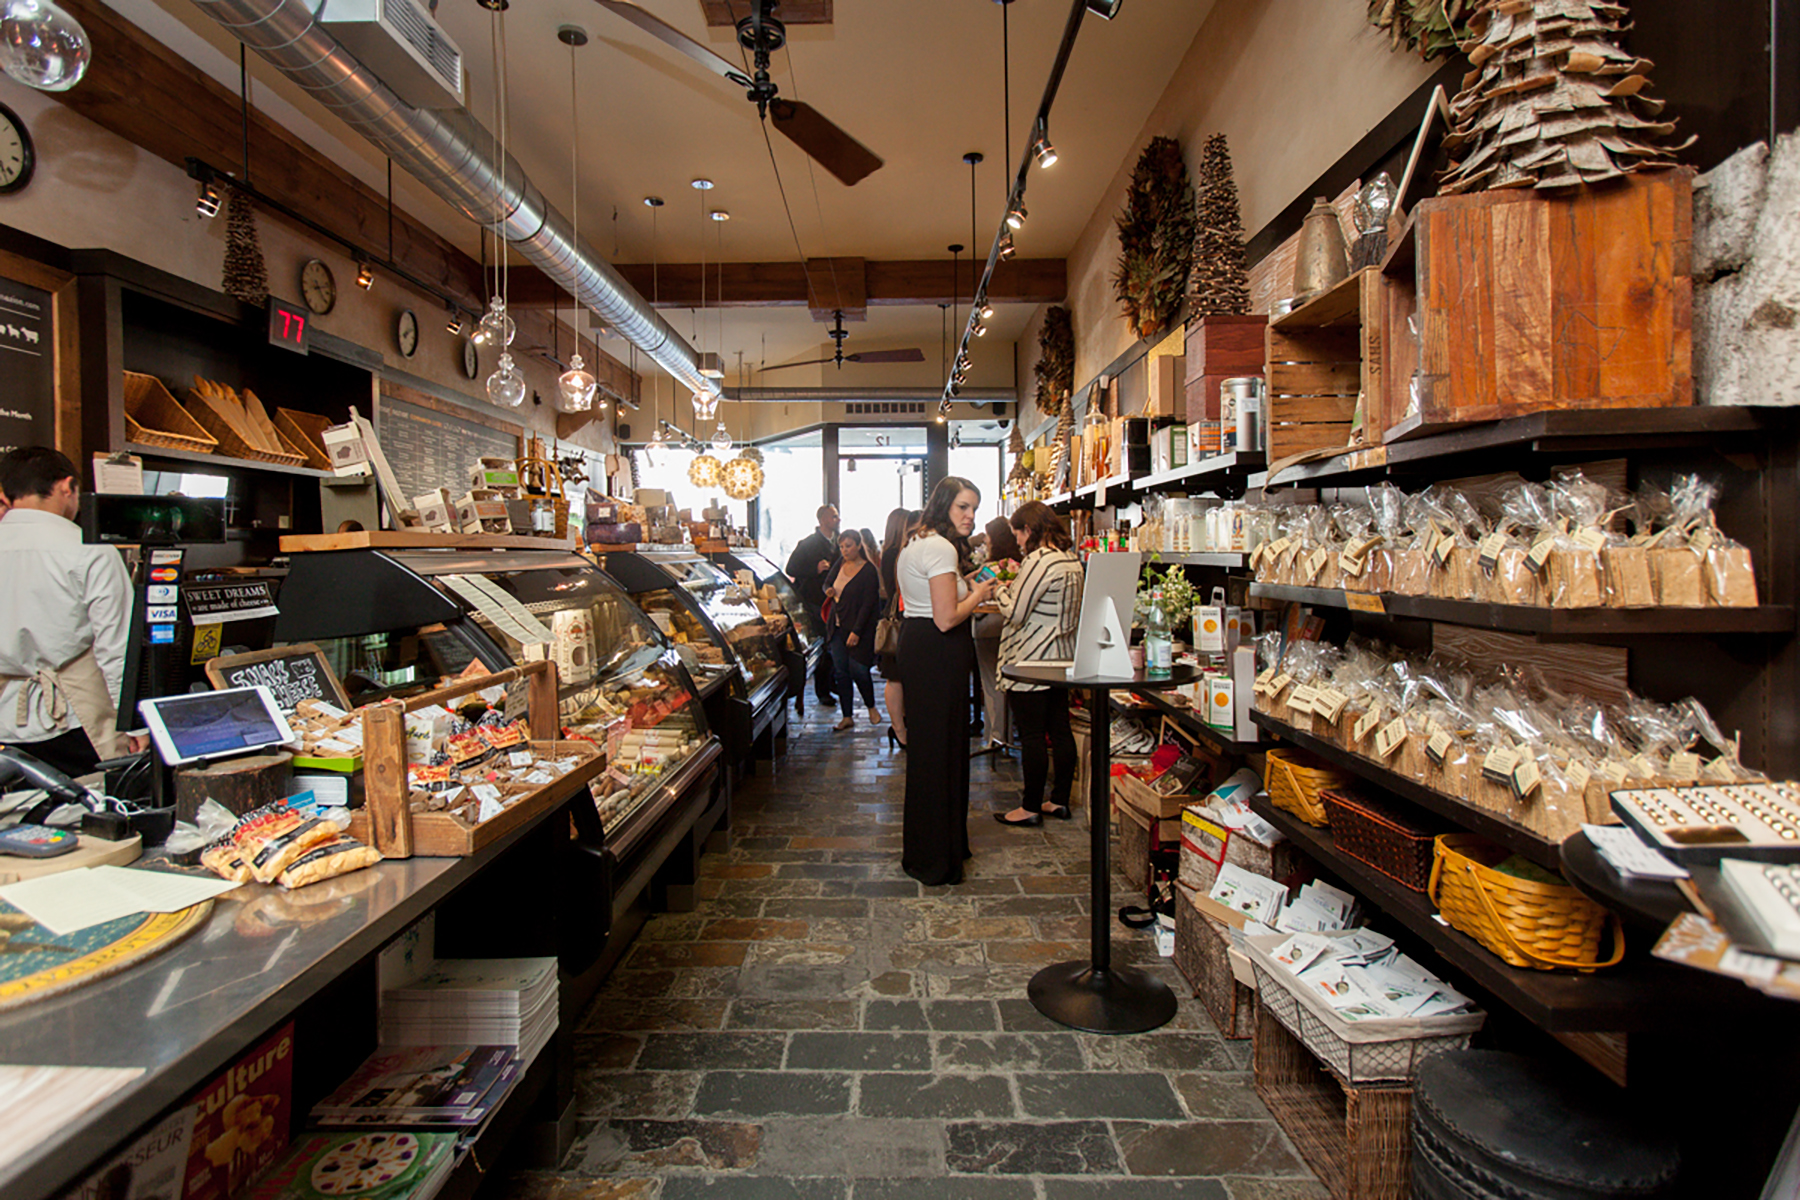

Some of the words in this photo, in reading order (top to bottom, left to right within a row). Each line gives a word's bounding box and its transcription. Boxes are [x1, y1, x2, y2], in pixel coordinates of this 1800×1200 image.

[278, 309, 305, 343] 77
[187, 589, 222, 602] SWEET
[224, 586, 267, 600] DREAMS
[151, 609, 176, 618] VISA
[195, 1036, 292, 1125] culture
